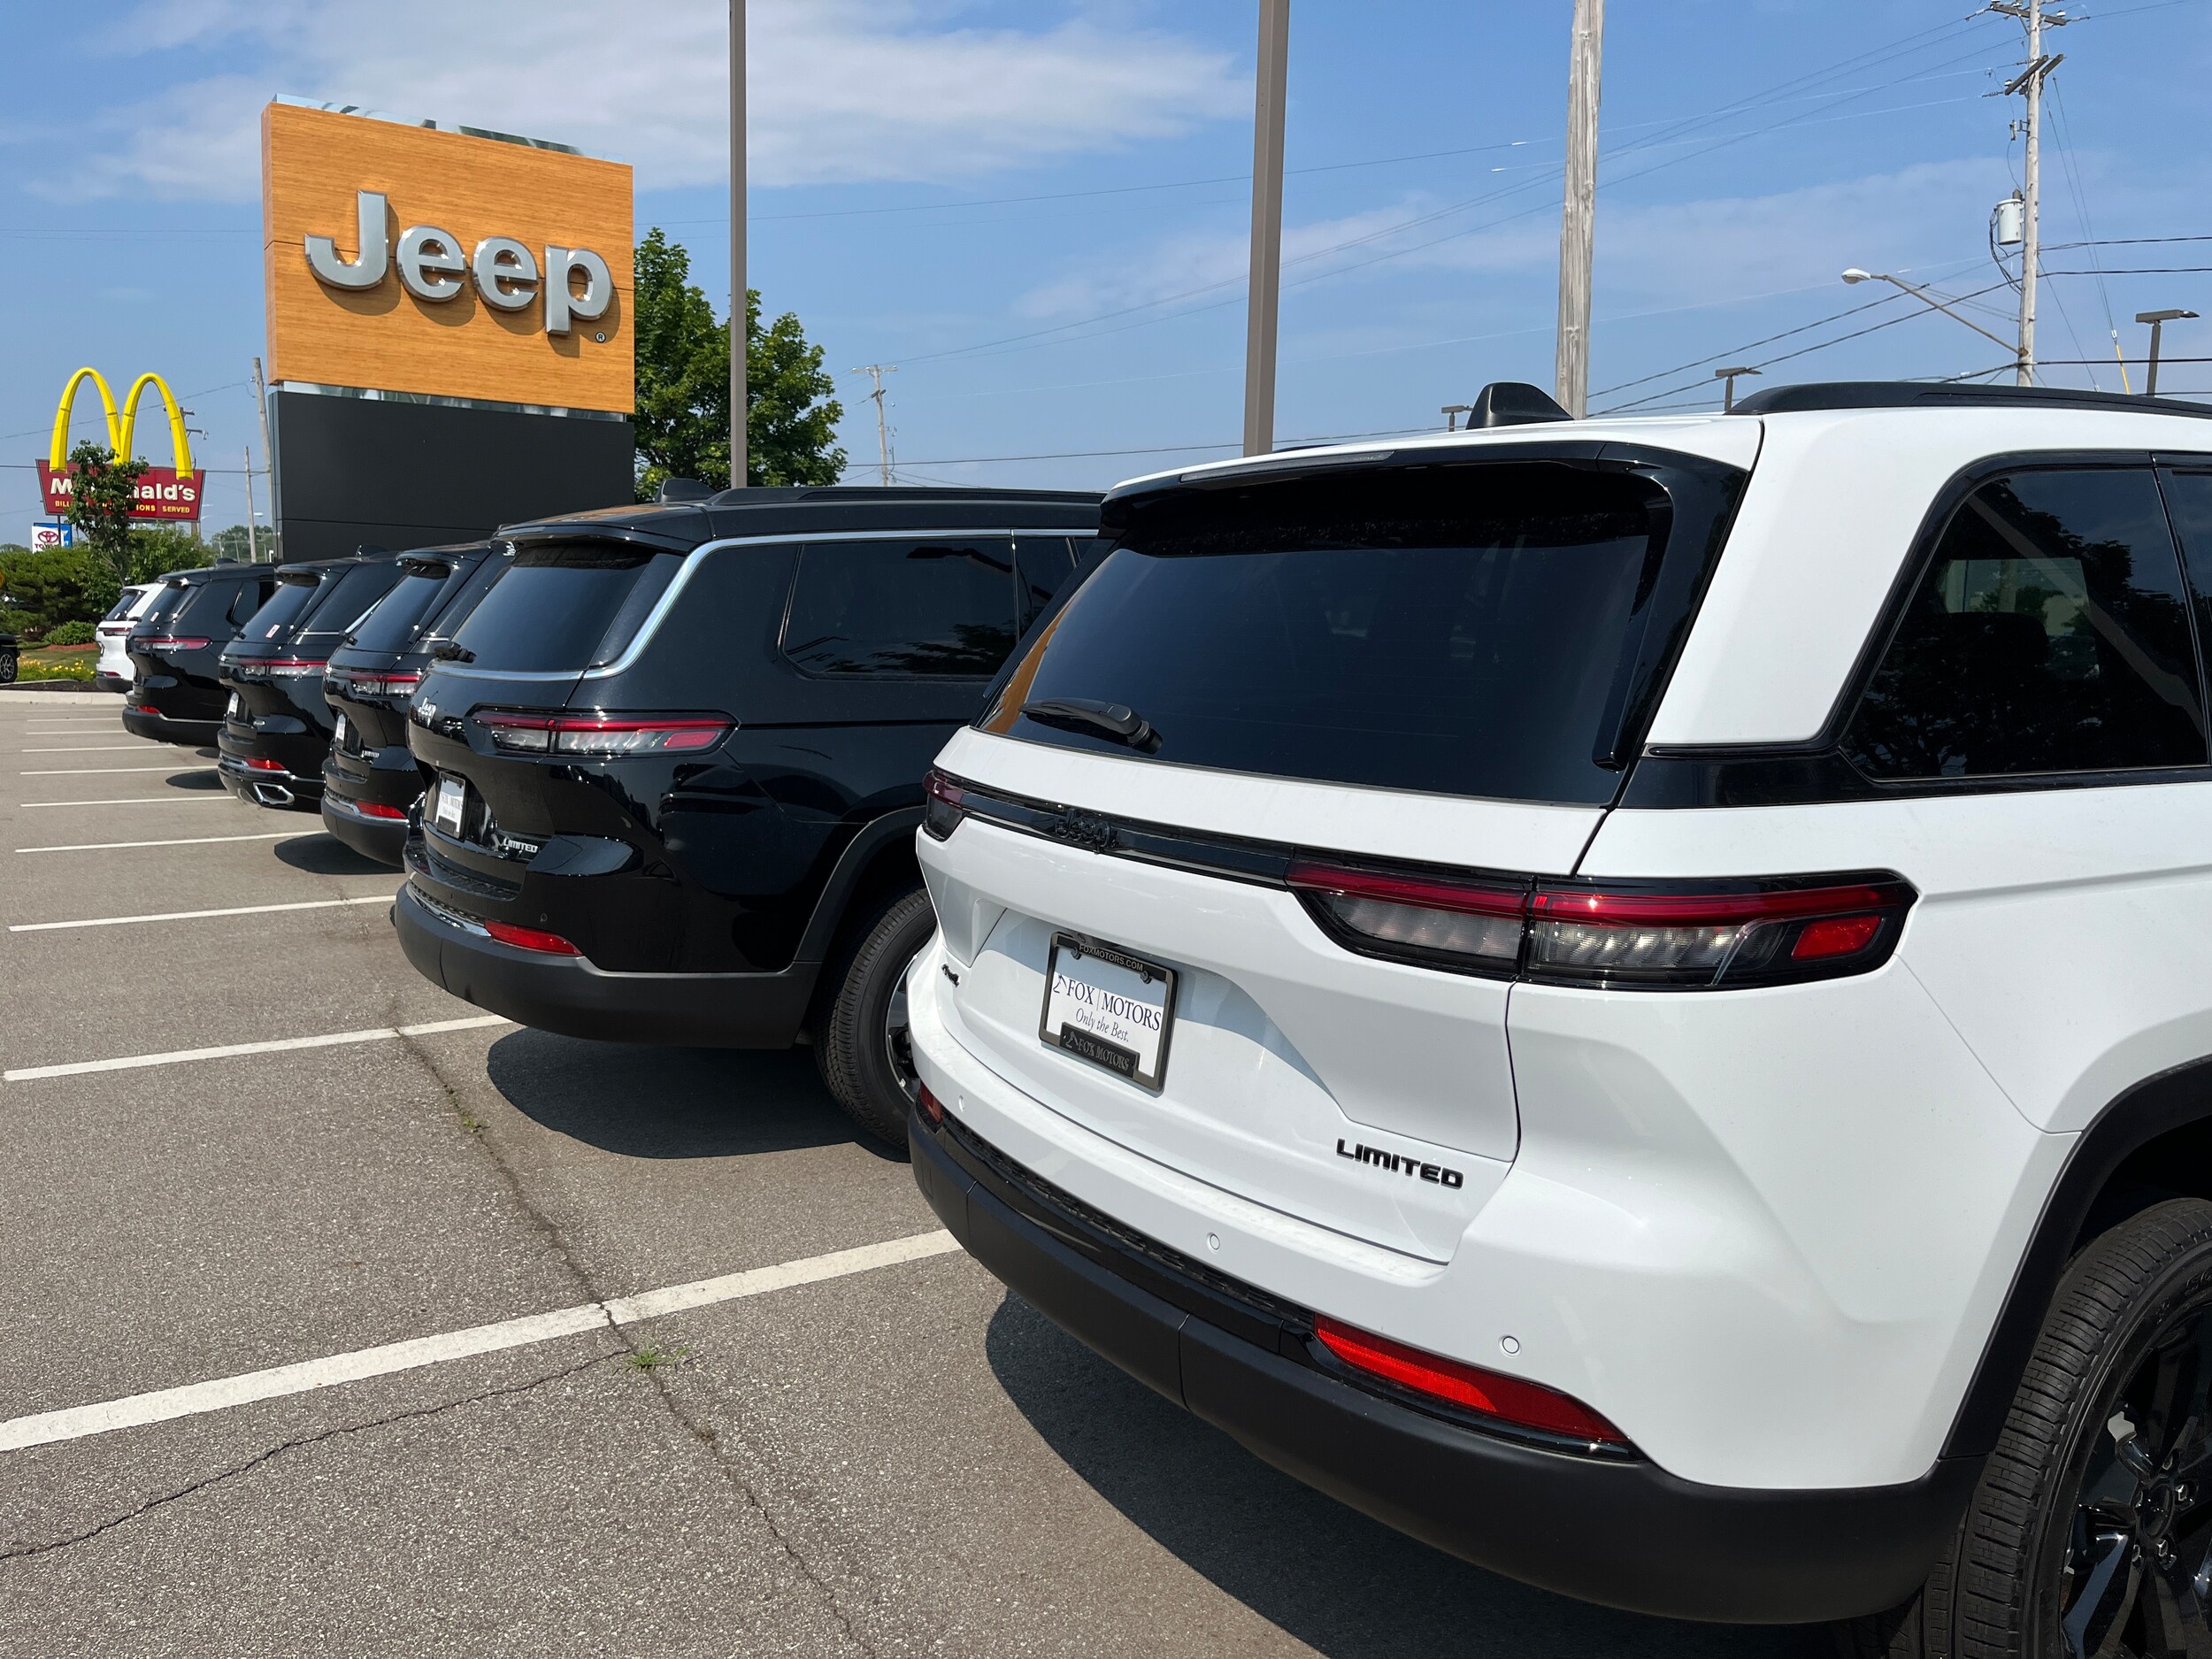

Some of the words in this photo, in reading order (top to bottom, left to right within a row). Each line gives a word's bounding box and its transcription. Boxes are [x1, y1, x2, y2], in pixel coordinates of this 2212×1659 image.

[304, 189, 613, 335] Jeep
[503, 837, 539, 853] LIMITED
[1054, 808, 1111, 855] Jeep
[1079, 944, 1144, 972] FOXMOTORS.COM
[1066, 979, 1095, 1005] FOX
[1101, 993, 1162, 1032] MOTORS
[1075, 1008, 1095, 1033] Only
[1096, 1017, 1110, 1033] the
[1110, 1021, 1129, 1042] Best.
[1078, 1040, 1095, 1058] FOX
[1095, 1046, 1130, 1071] MOTORS
[1336, 1138, 1464, 1190] LIMITED
